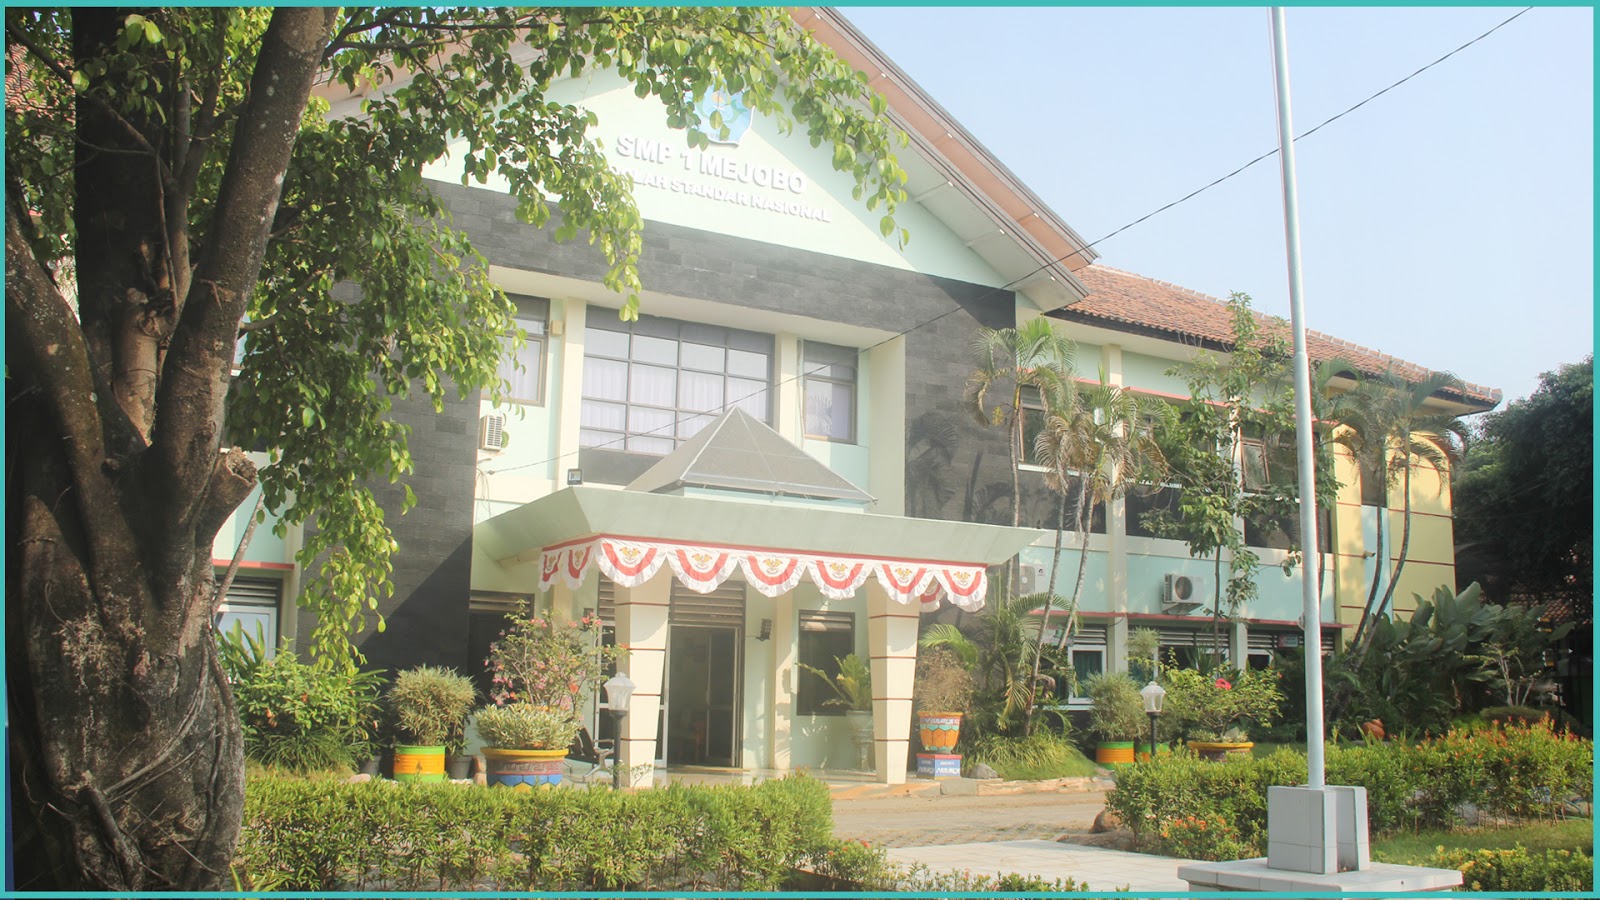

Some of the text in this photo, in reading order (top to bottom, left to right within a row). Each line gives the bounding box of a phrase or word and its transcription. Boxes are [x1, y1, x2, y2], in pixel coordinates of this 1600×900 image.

[616, 133, 808, 195] SMP 1 MEJOBO
[670, 176, 749, 206] STANDAR
[750, 194, 831, 223] NASIONAL
